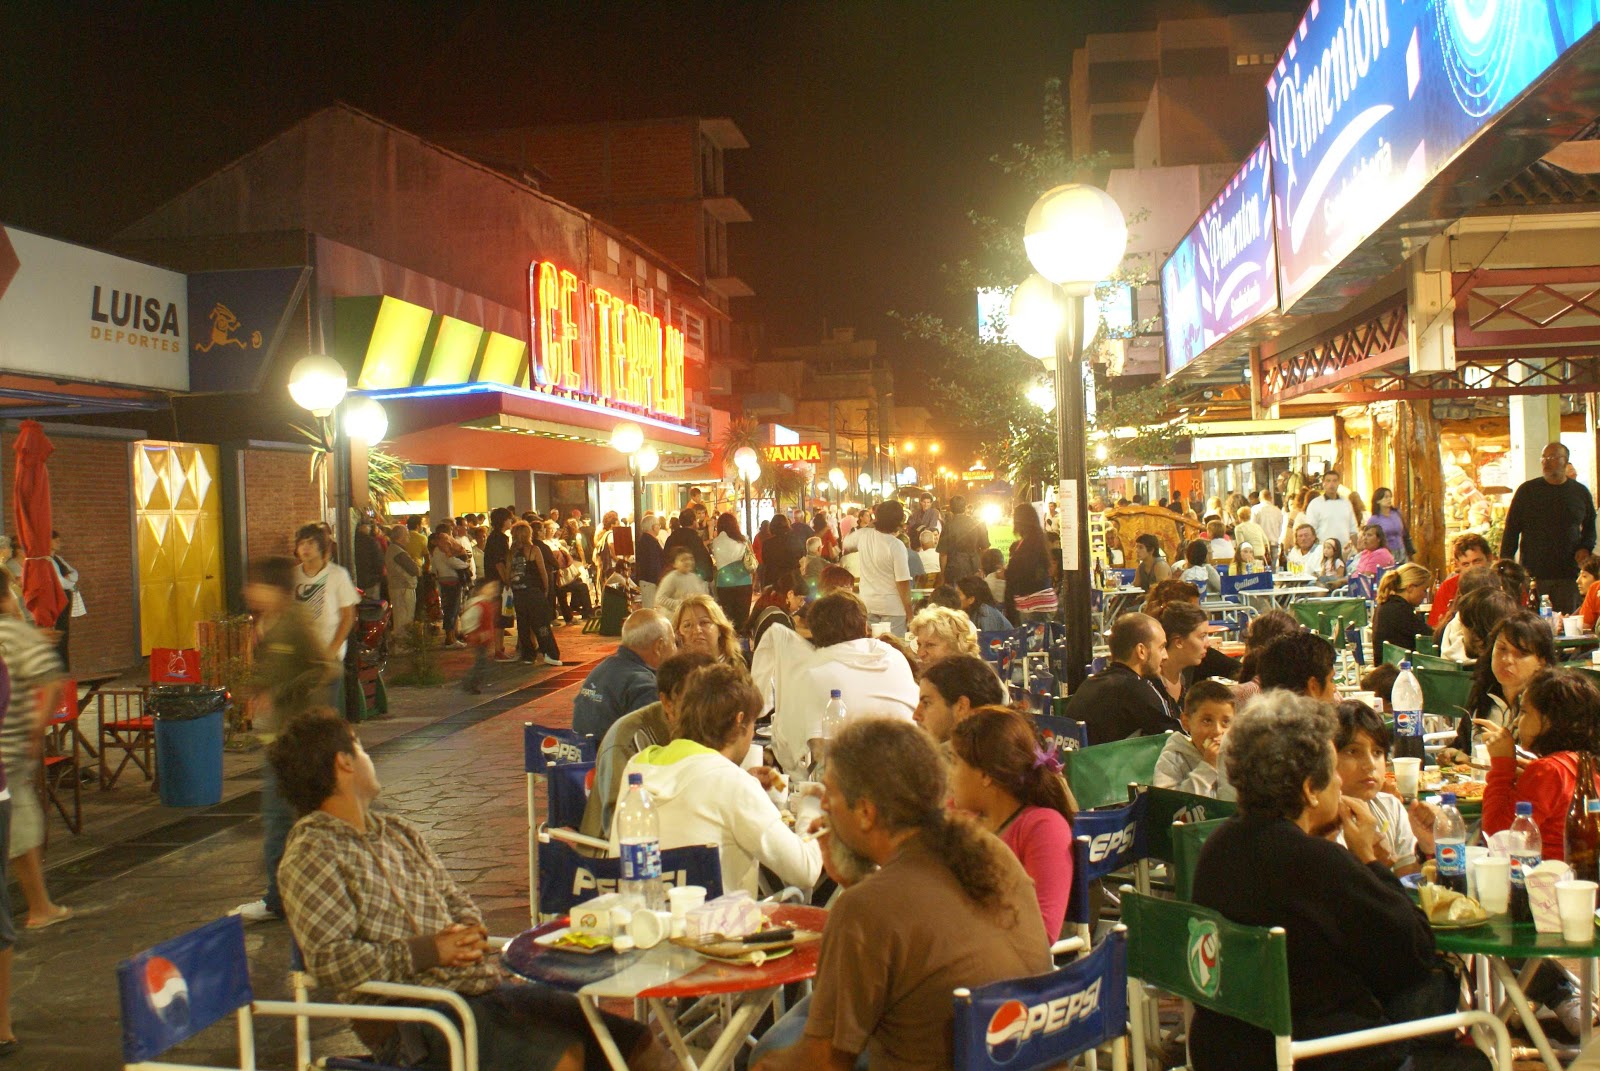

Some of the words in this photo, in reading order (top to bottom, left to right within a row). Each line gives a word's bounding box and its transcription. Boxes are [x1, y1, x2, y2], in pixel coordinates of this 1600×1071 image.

[91, 285, 180, 337] LUISA
[91, 326, 180, 353] DEPORTES
[763, 445, 821, 462] VANNA
[1088, 821, 1137, 862] EPSI
[1021, 976, 1102, 1040] PEPSI
